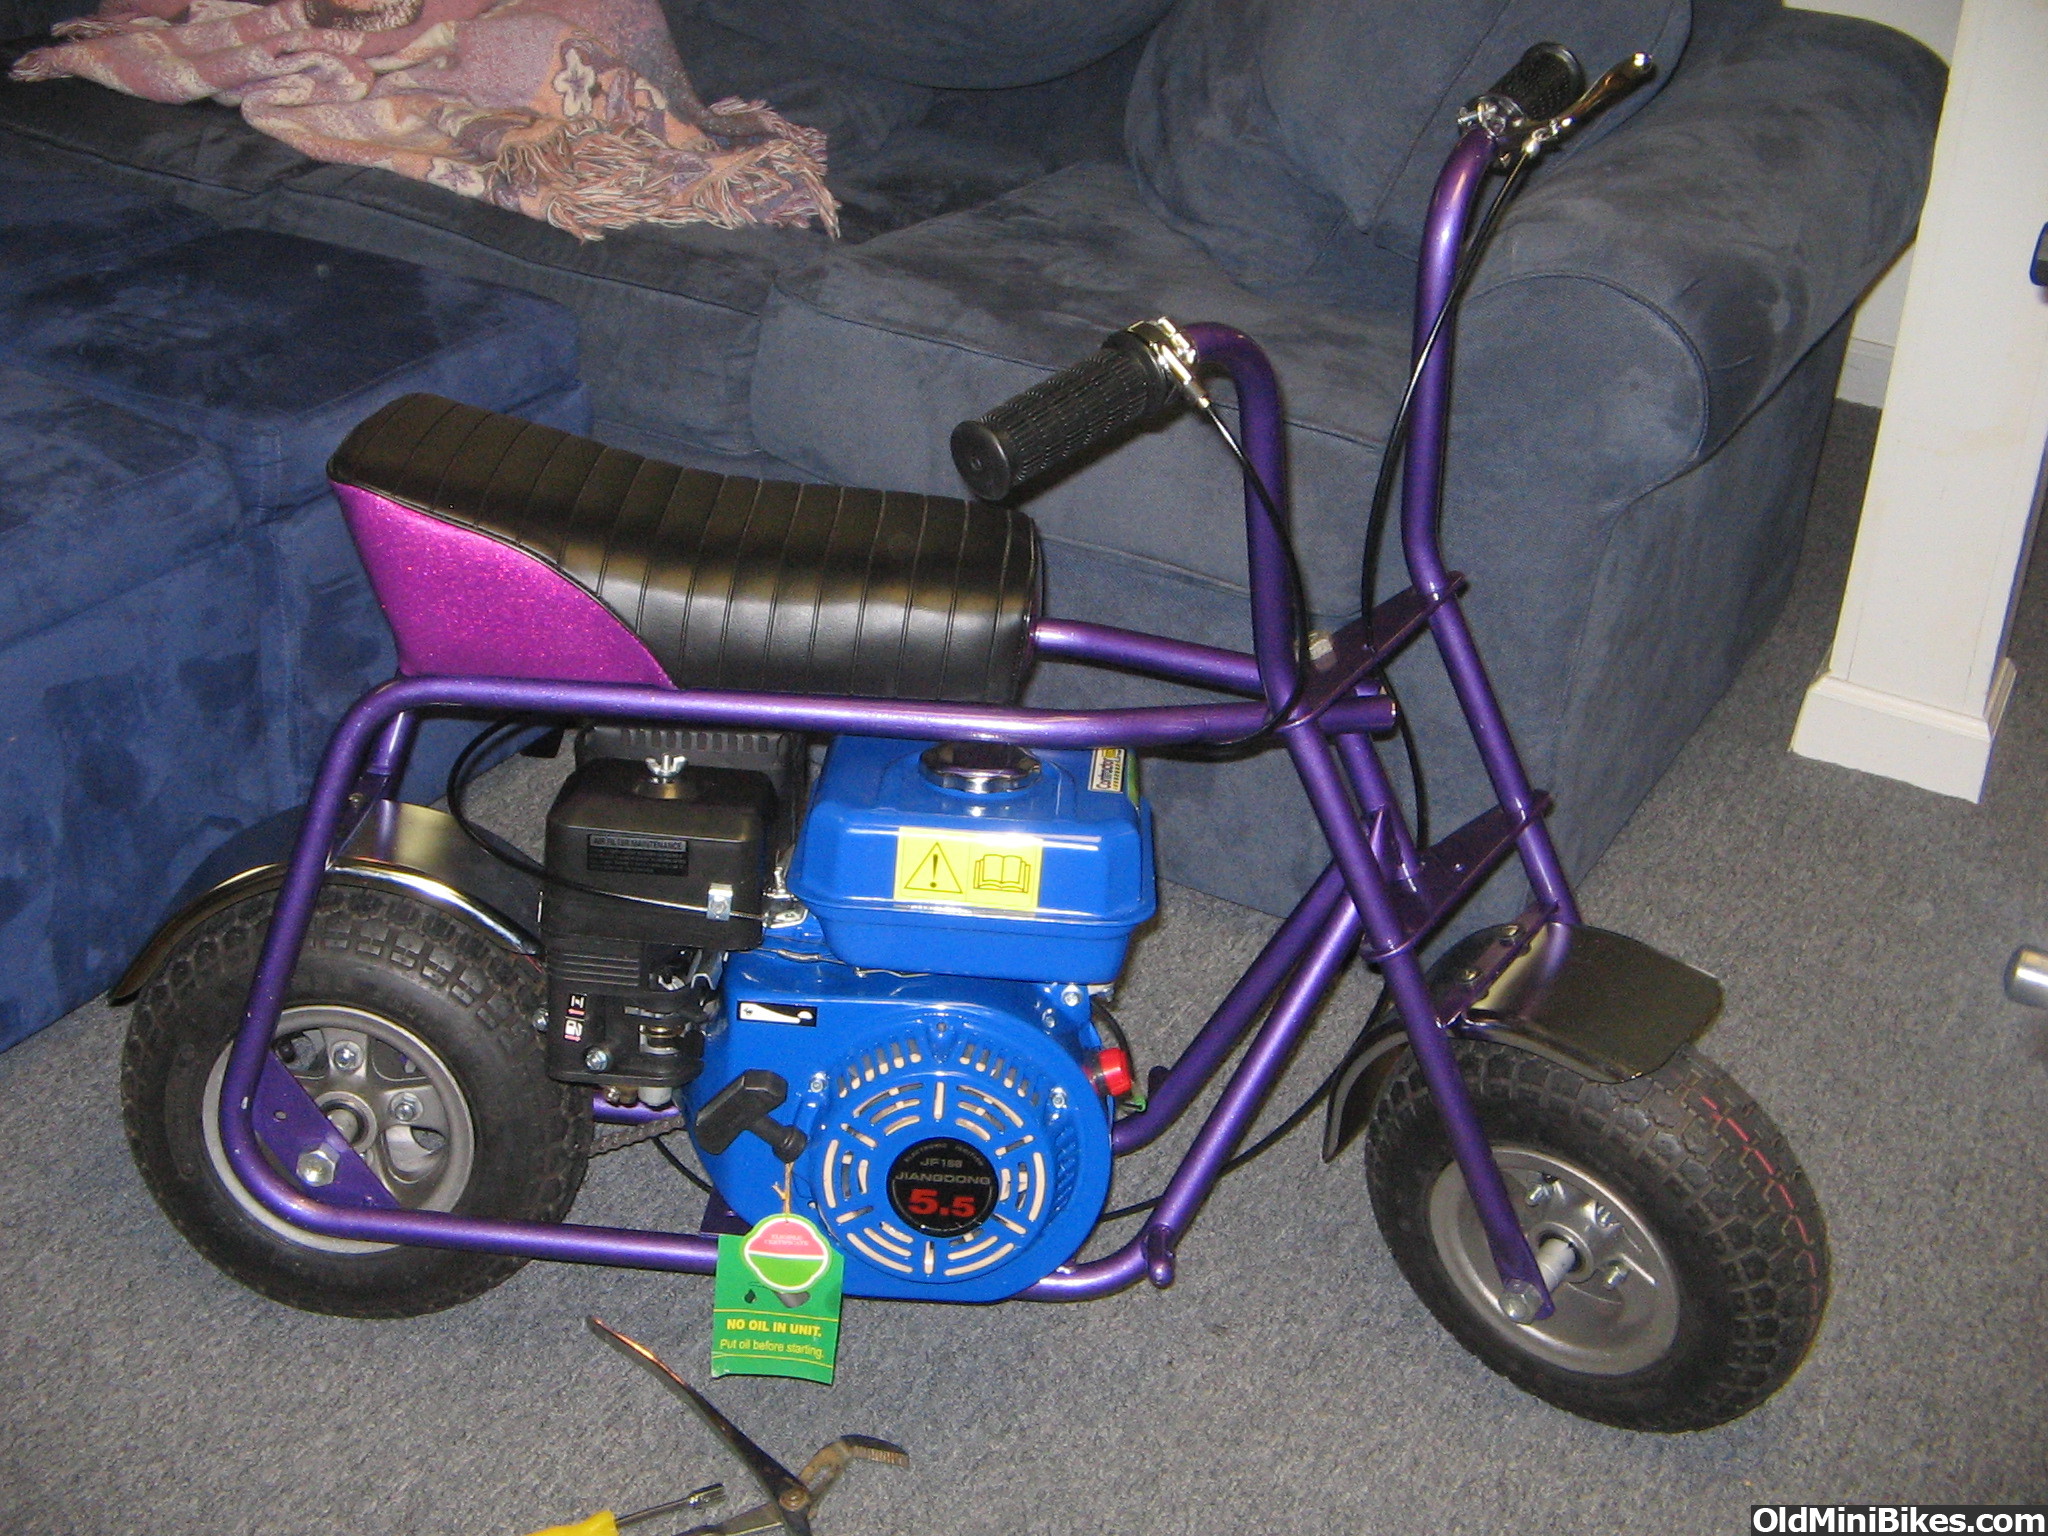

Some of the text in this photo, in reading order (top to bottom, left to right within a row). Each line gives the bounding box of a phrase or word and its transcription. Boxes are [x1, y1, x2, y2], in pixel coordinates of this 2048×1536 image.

[895, 1172, 991, 1185] JIANGDONG
[908, 1188, 976, 1218] 5.5
[726, 1319, 822, 1337] NO OIL IN UNIT.
[720, 1338, 824, 1360] Put oil before starting.
